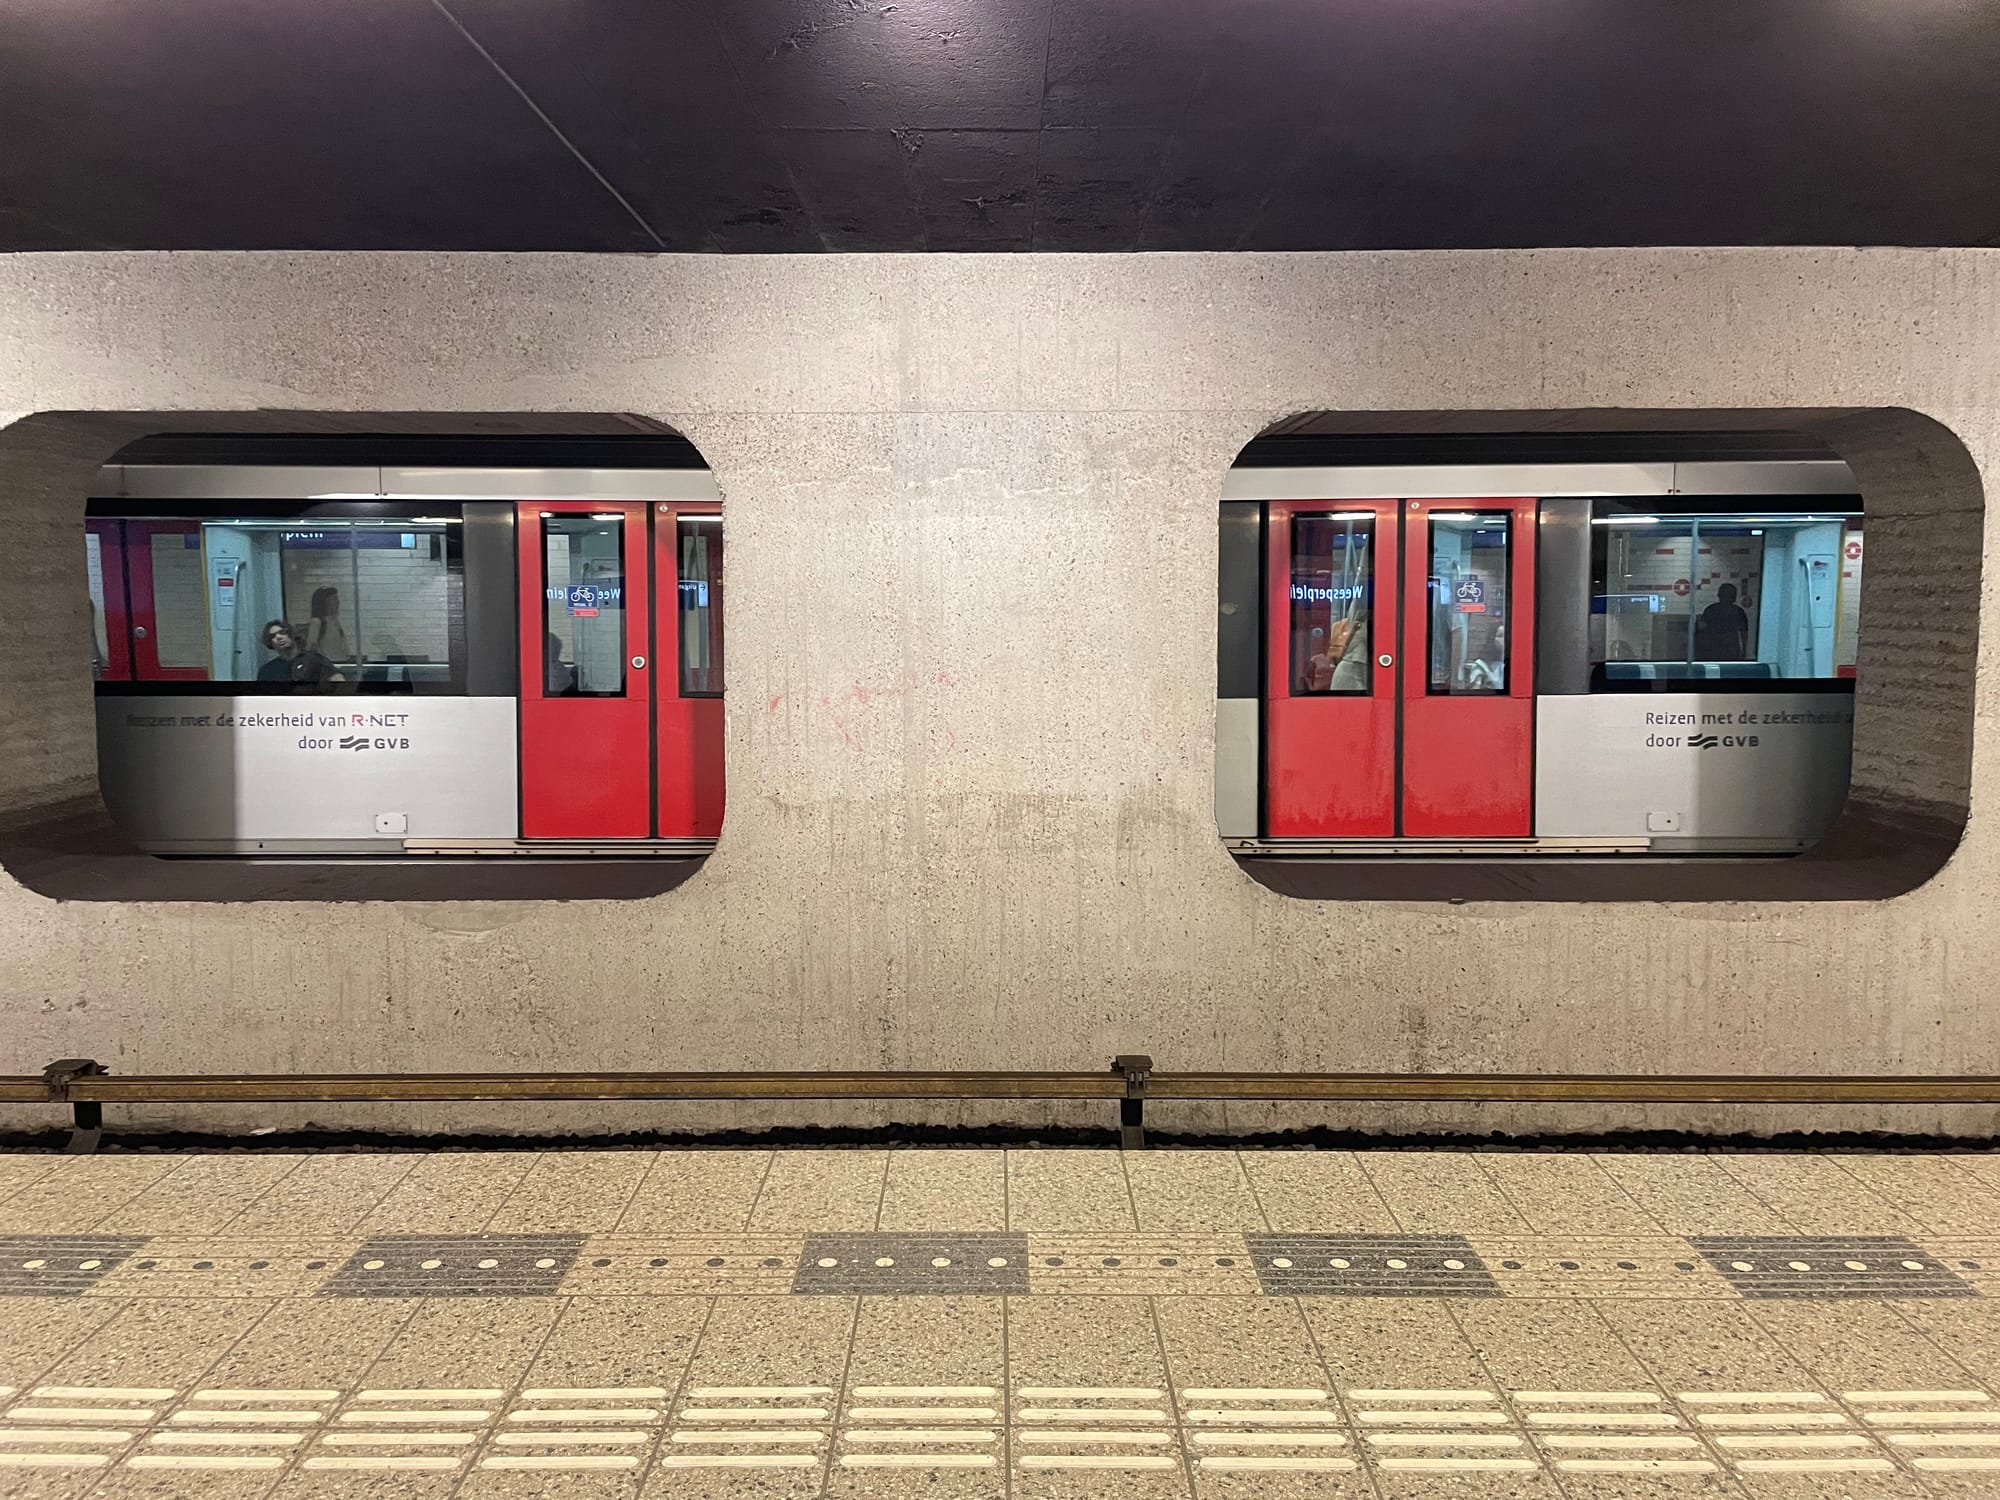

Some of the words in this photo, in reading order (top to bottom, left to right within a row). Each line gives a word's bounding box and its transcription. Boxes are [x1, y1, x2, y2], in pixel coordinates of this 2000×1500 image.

[215, 712, 235, 727] de
[239, 712, 314, 727] zekerheid
[319, 715, 346, 727] van
[1645, 712, 1696, 725] Reizen
[1701, 713, 1732, 725] met
[1738, 710, 1759, 725] de
[298, 735, 333, 749] door
[374, 738, 410, 749] GVB
[1645, 734, 1682, 748] door
[1722, 735, 1760, 748] GVB
